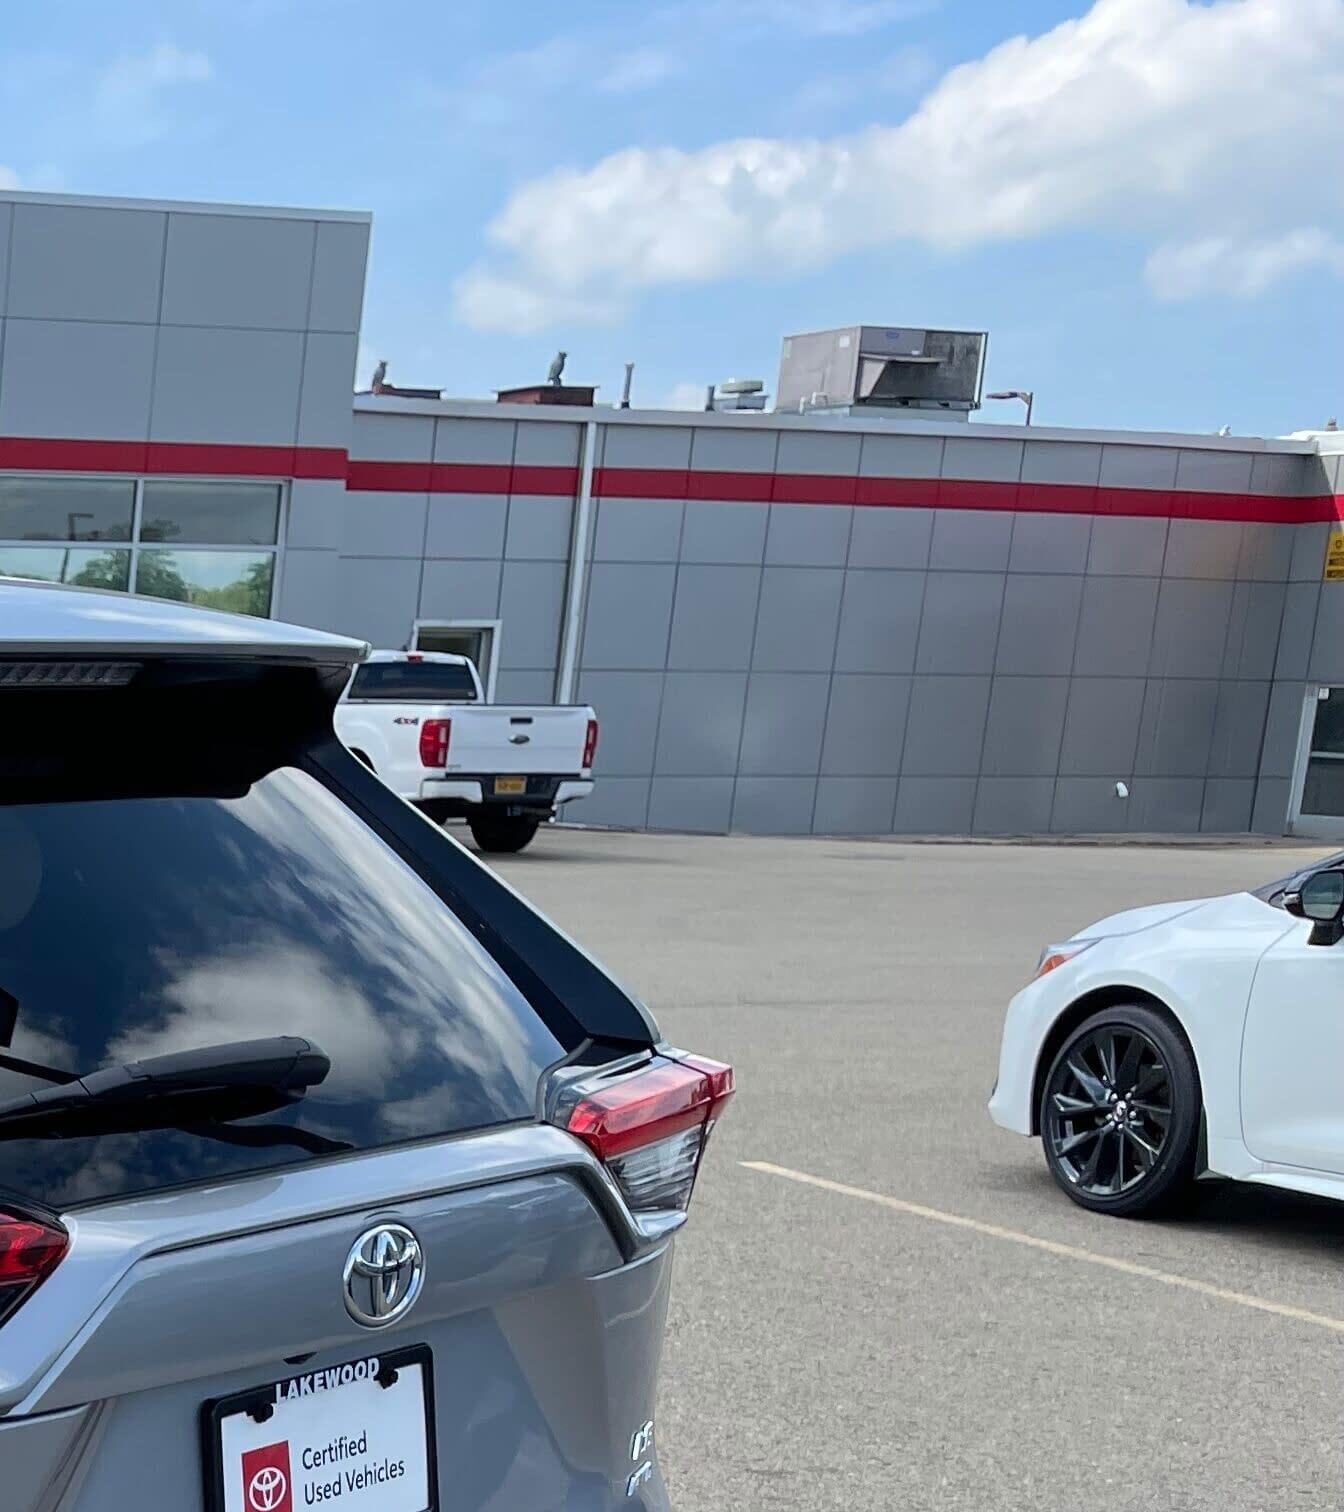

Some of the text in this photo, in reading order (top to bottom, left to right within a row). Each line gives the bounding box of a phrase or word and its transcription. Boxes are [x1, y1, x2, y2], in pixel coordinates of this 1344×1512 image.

[275, 1357, 381, 1405] LAKEWOOD
[301, 1430, 368, 1470] Certified
[304, 1458, 406, 1506] Used Vehicles
